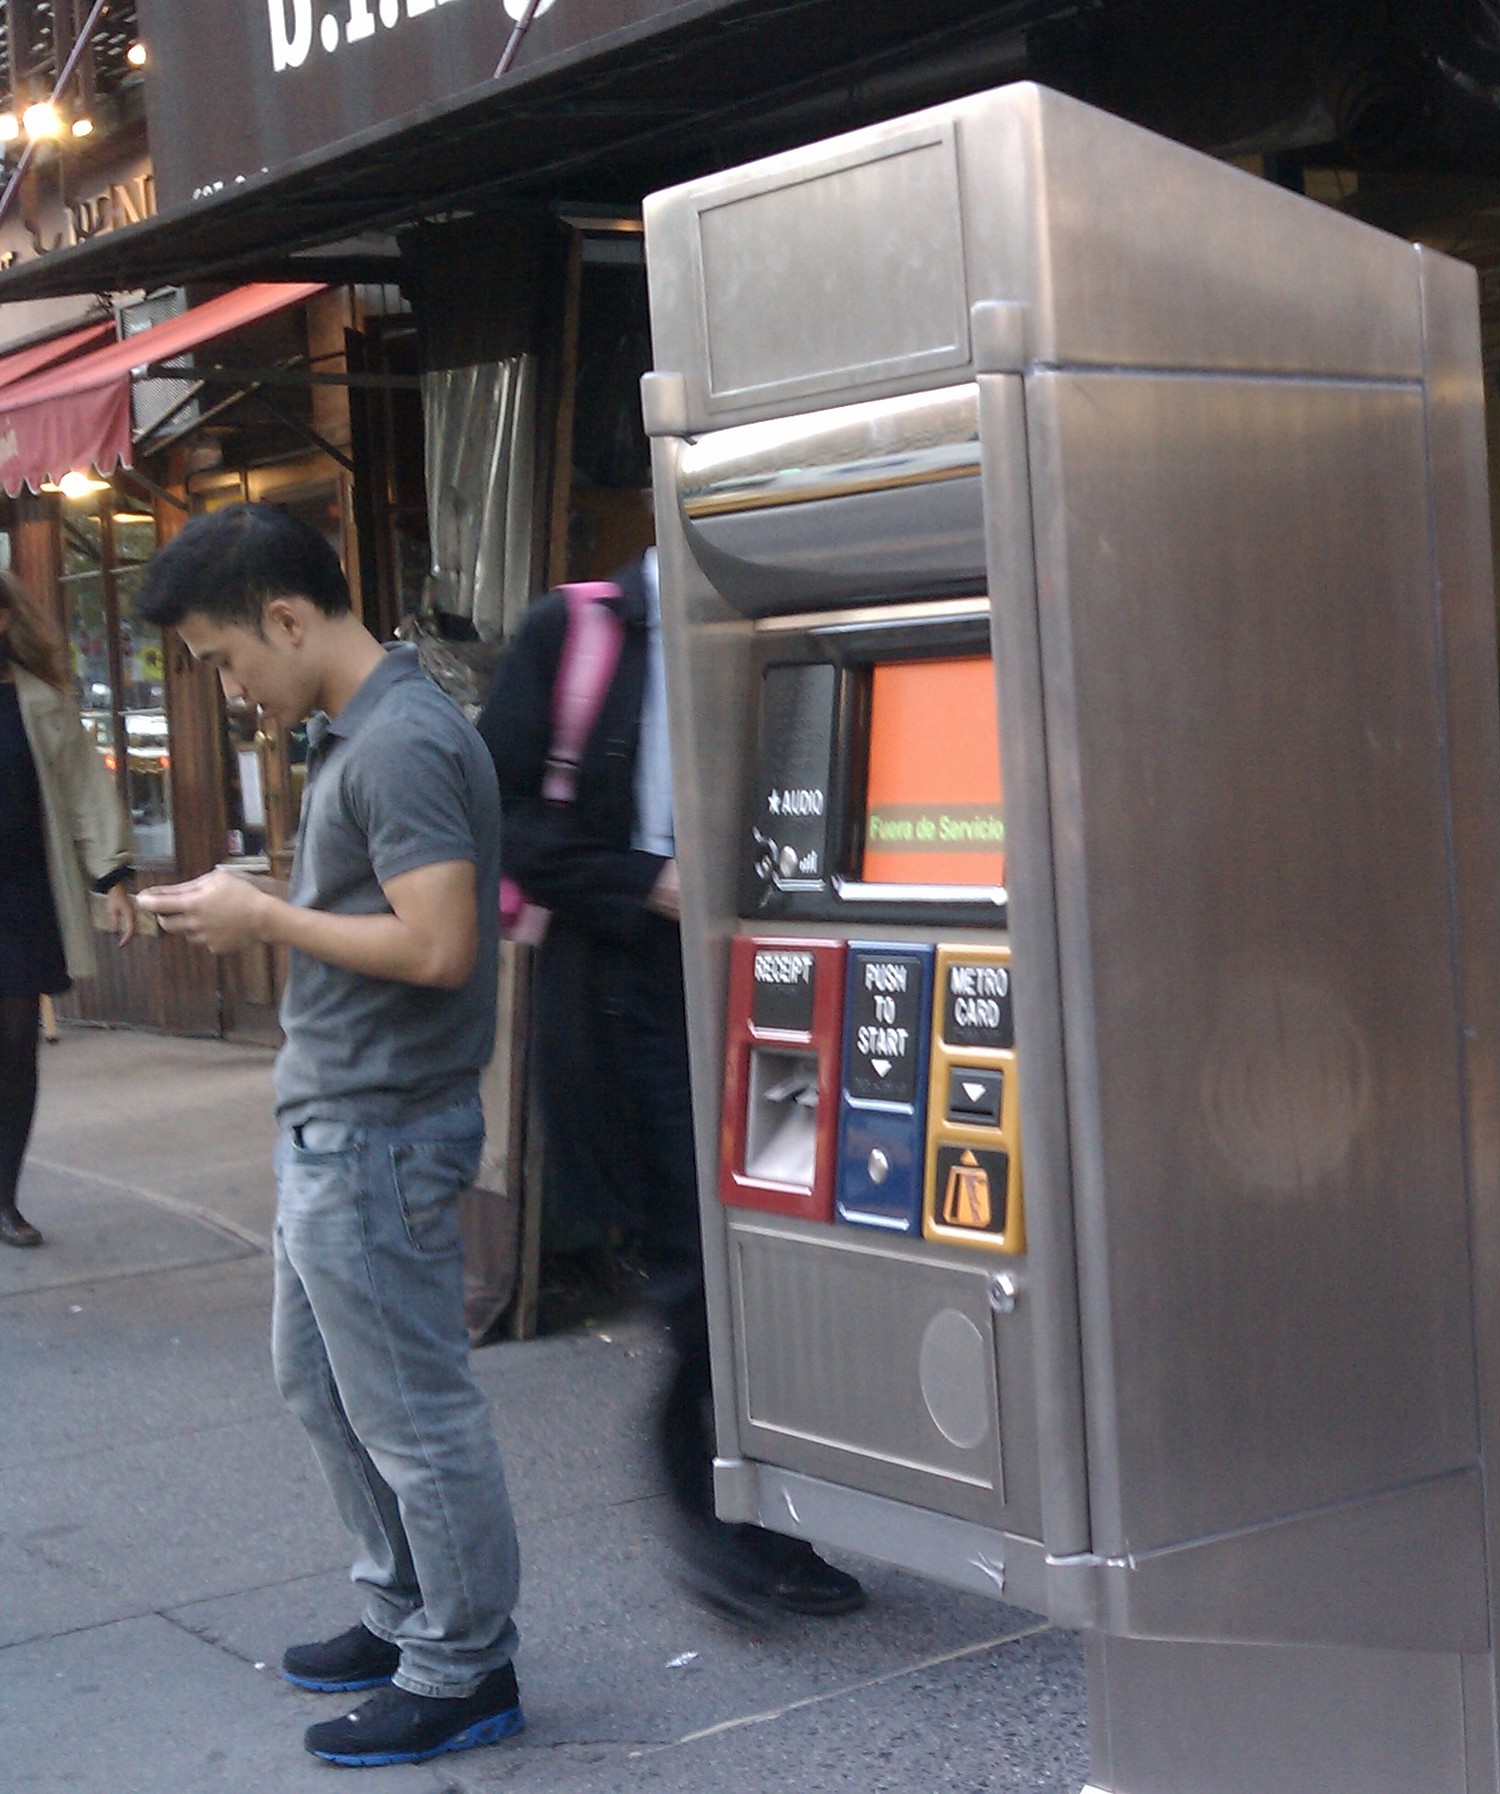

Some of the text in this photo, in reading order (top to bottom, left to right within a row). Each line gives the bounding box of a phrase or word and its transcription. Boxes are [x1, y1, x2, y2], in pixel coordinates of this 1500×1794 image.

[781, 788, 825, 817] AUDIO
[870, 814, 1005, 842] Fuera de Servicio
[754, 955, 814, 985] RECEIPT
[864, 963, 907, 994] PUSH
[949, 966, 1008, 999] METRO
[874, 995, 897, 1026] TO
[954, 998, 1001, 1030] CARD
[856, 1027, 910, 1058] START
